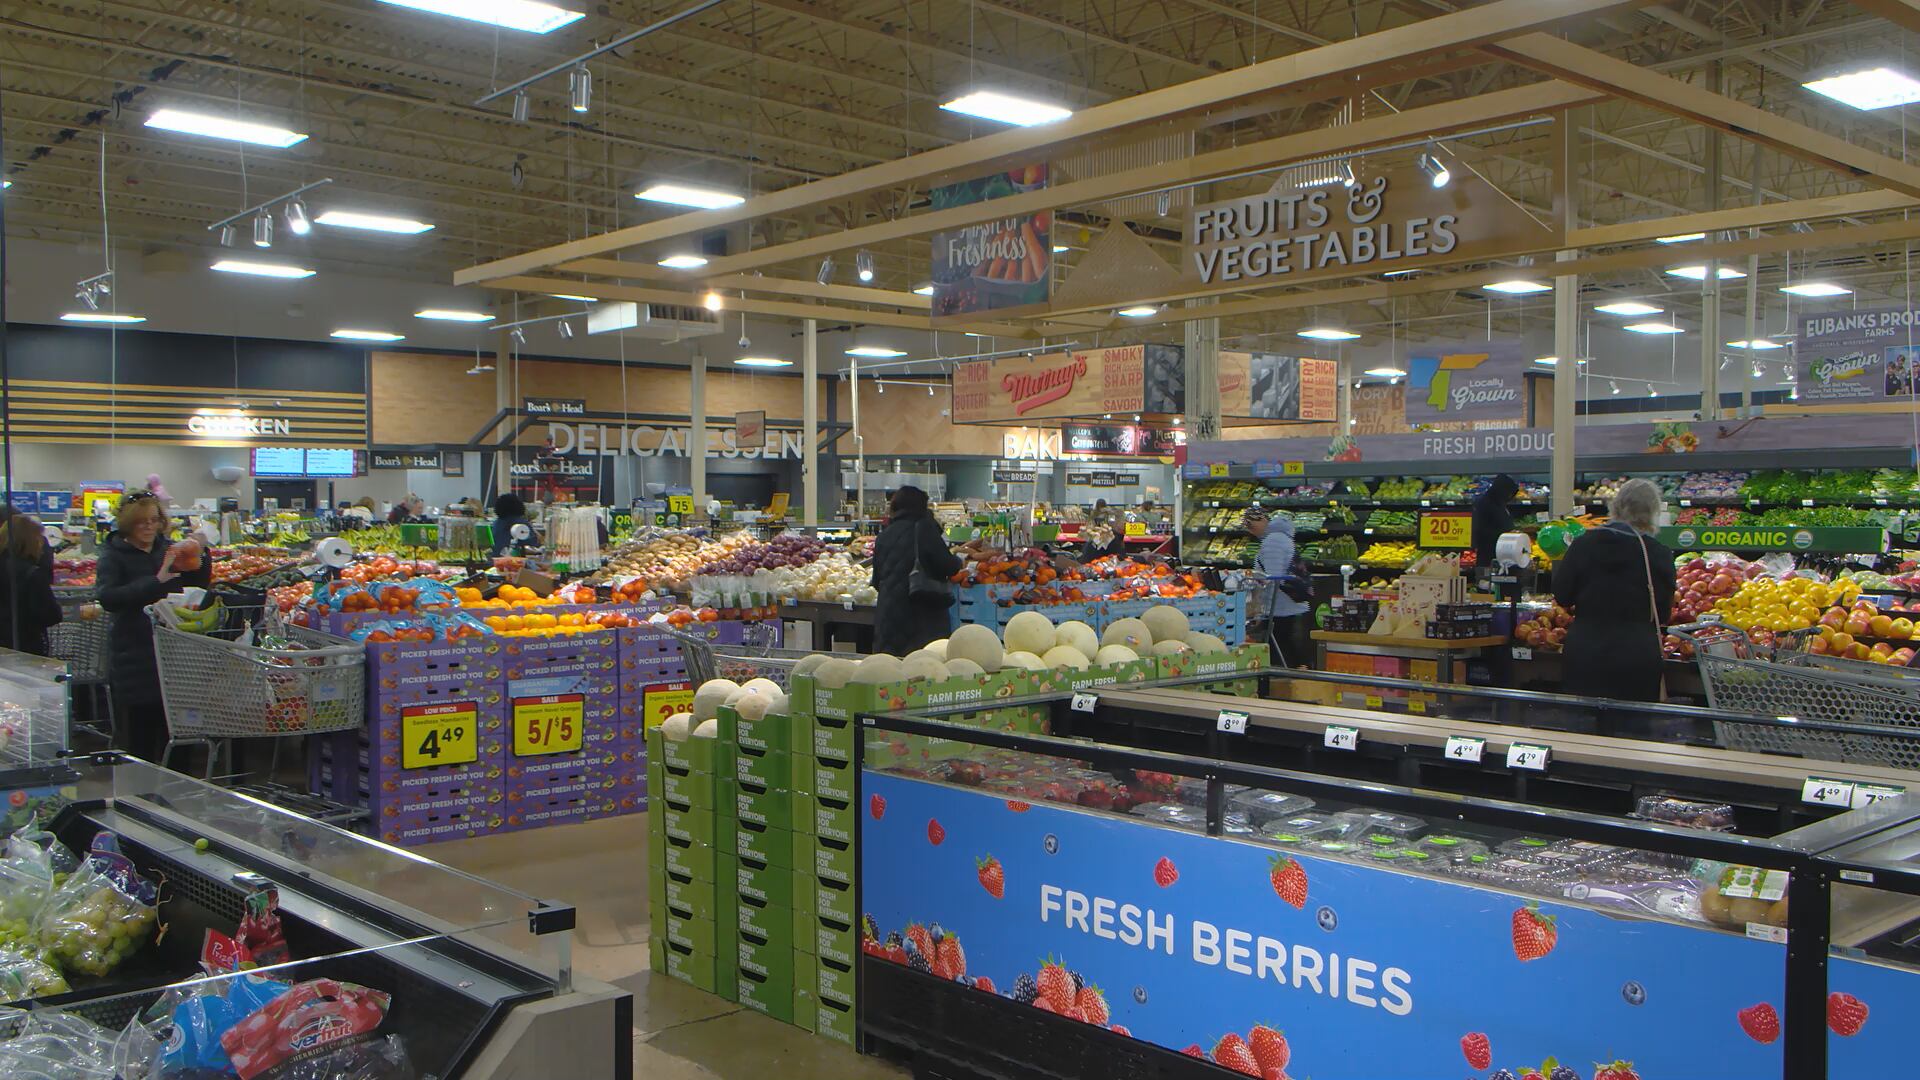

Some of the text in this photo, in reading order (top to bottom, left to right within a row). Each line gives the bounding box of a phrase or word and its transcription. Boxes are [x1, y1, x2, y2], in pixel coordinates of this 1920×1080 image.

[1194, 176, 1386, 244] FRUITS &
[948, 236, 1027, 268] Freshness
[1194, 215, 1456, 283] VEGETABLES
[1807, 314, 1875, 338] EUBANKS
[1865, 328, 1895, 337] FARMS
[1104, 347, 1144, 362] SMOKY
[1105, 365, 1121, 373] RICH
[1315, 362, 1334, 374] RICH
[1816, 353, 1880, 384] Grown
[1000, 355, 1088, 408] Murray's
[1104, 373, 1142, 388] SHARP
[1470, 378, 1504, 389] Locally
[1303, 361, 1313, 418] BUTTERY
[955, 393, 990, 410] BUTTERY
[1452, 387, 1517, 410] Grown
[528, 402, 583, 413] Boar's Head
[1104, 399, 1142, 411] SAVORY
[188, 416, 289, 435] CKEN
[549, 422, 802, 459] DELICATESEN
[1424, 433, 1555, 455] FRESH PRODUC
[375, 456, 437, 466] Boar's Head
[560, 460, 593, 475] Head
[1011, 472, 1036, 480] BREADS
[1430, 519, 1450, 534] 20
[1701, 531, 1787, 546] ORGANIC
[1197, 662, 1236, 674] FARM FRESH
[1072, 676, 1116, 691] FARM FRESH
[816, 690, 832, 698] FRESH
[928, 689, 982, 704] FARM FRESH
[816, 698, 826, 706] FOR
[1077, 698, 1090, 708] 699
[816, 706, 848, 717] EVERYONE.
[738, 721, 753, 731] FRESH
[1224, 719, 1239, 729] 899
[816, 730, 832, 738] FRESH
[419, 727, 464, 758] 449
[738, 737, 768, 748] EVERYONE.
[816, 738, 826, 746] FOR
[1332, 735, 1349, 745] 499
[816, 746, 848, 757] EVERYONE.
[1454, 745, 1473, 756] 499
[738, 757, 753, 767] FRESH
[1516, 753, 1536, 765] 479
[526, 763, 550, 772] PICKED
[552, 761, 571, 769] FRESH
[738, 773, 768, 784] EVERYONE.
[817, 770, 833, 779] FRESH
[402, 778, 428, 787] PICKED
[430, 775, 451, 784] FRESH
[818, 778, 828, 786] FOR
[526, 788, 550, 796] PICKED
[552, 785, 571, 794] FRESH
[818, 786, 849, 797] EVERYONE.
[1814, 787, 1840, 801] 449
[738, 794, 754, 804] FRESH
[404, 803, 430, 812] PICKED
[432, 801, 452, 809] FRESH
[739, 810, 768, 821] EVERYONE.
[818, 810, 834, 818] FRESH
[818, 818, 828, 826] FOR
[404, 828, 430, 838] PICKED
[432, 825, 453, 834] FRESH
[818, 826, 849, 837] EVERYONE.
[1040, 883, 1413, 1016] FRESH BERRIES
